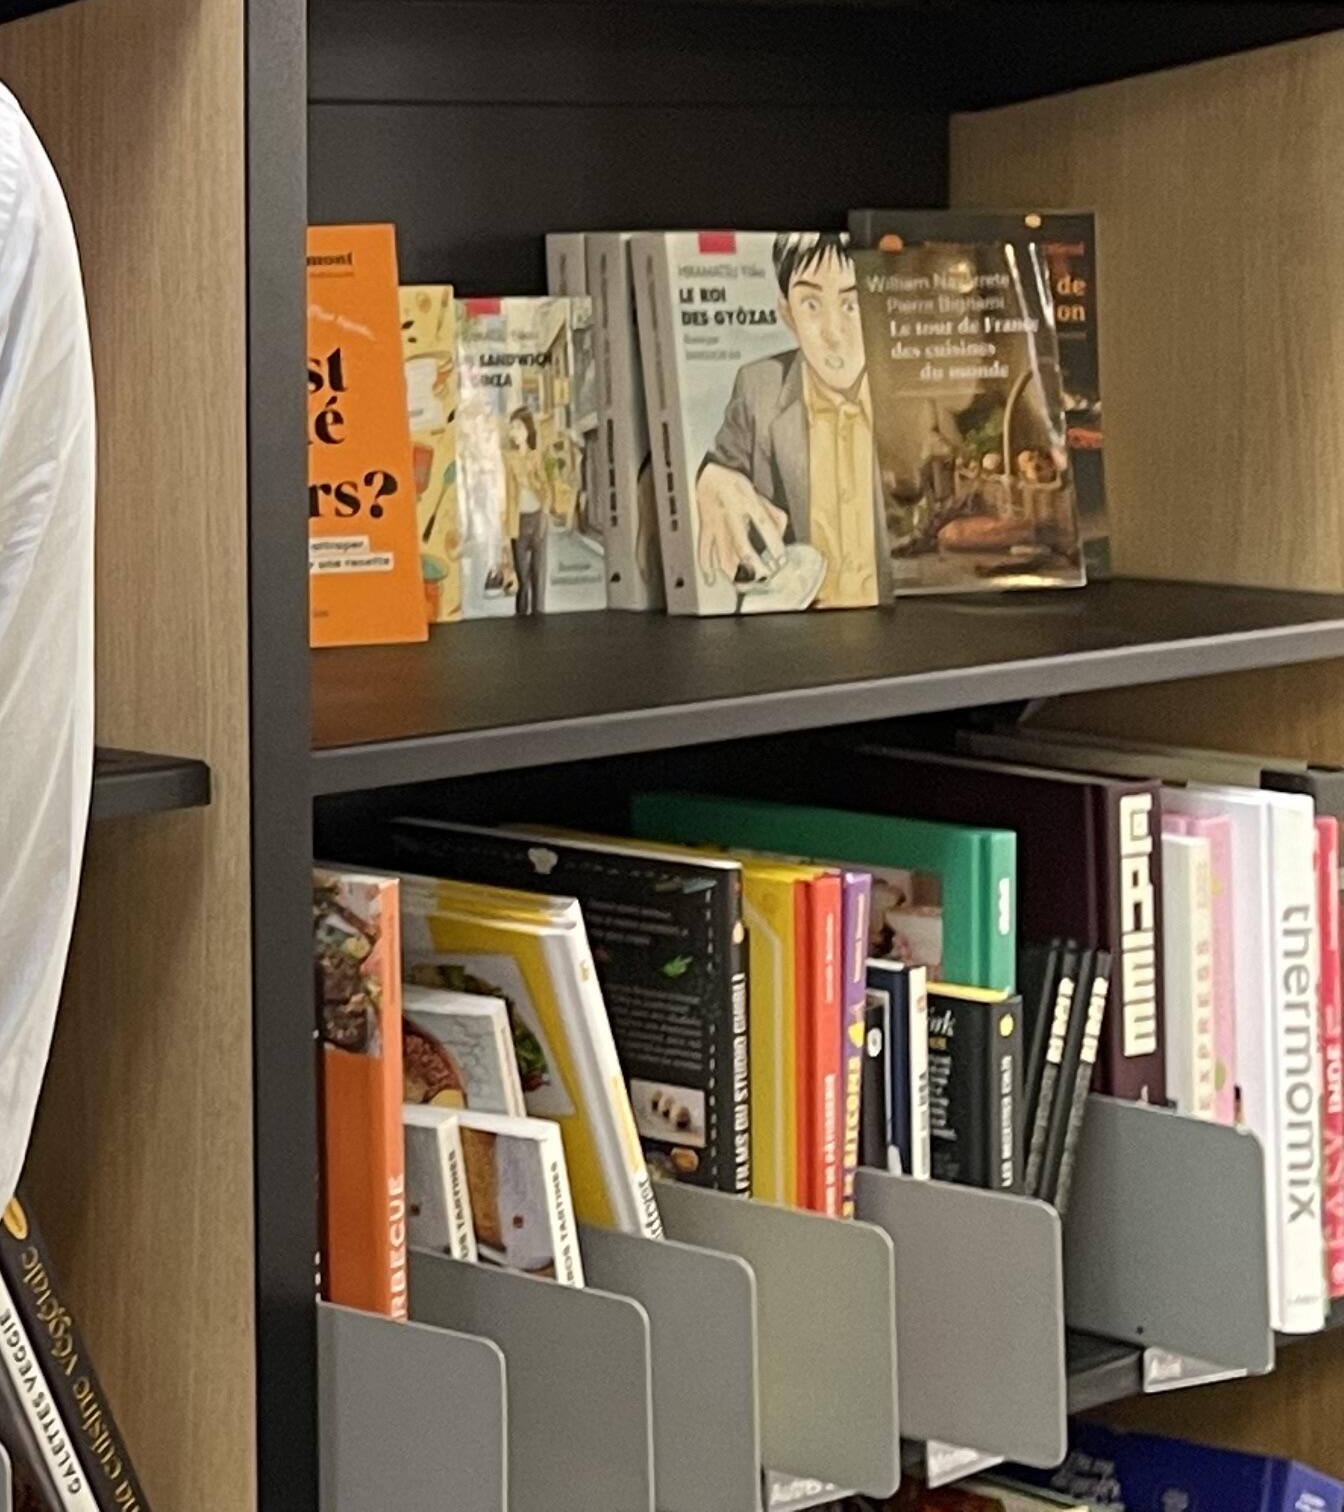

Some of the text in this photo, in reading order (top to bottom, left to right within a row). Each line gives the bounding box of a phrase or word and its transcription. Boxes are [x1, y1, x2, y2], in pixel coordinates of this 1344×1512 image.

[934, 272, 1011, 290] Narrete
[681, 309, 709, 326] DES
[307, 397, 346, 448] é
[733, 1035, 749, 1103] STUDIO
[1280, 902, 1317, 1224] thermomix
[31, 1390, 83, 1495] GALETTES
[72, 1376, 124, 1483] cuisine
